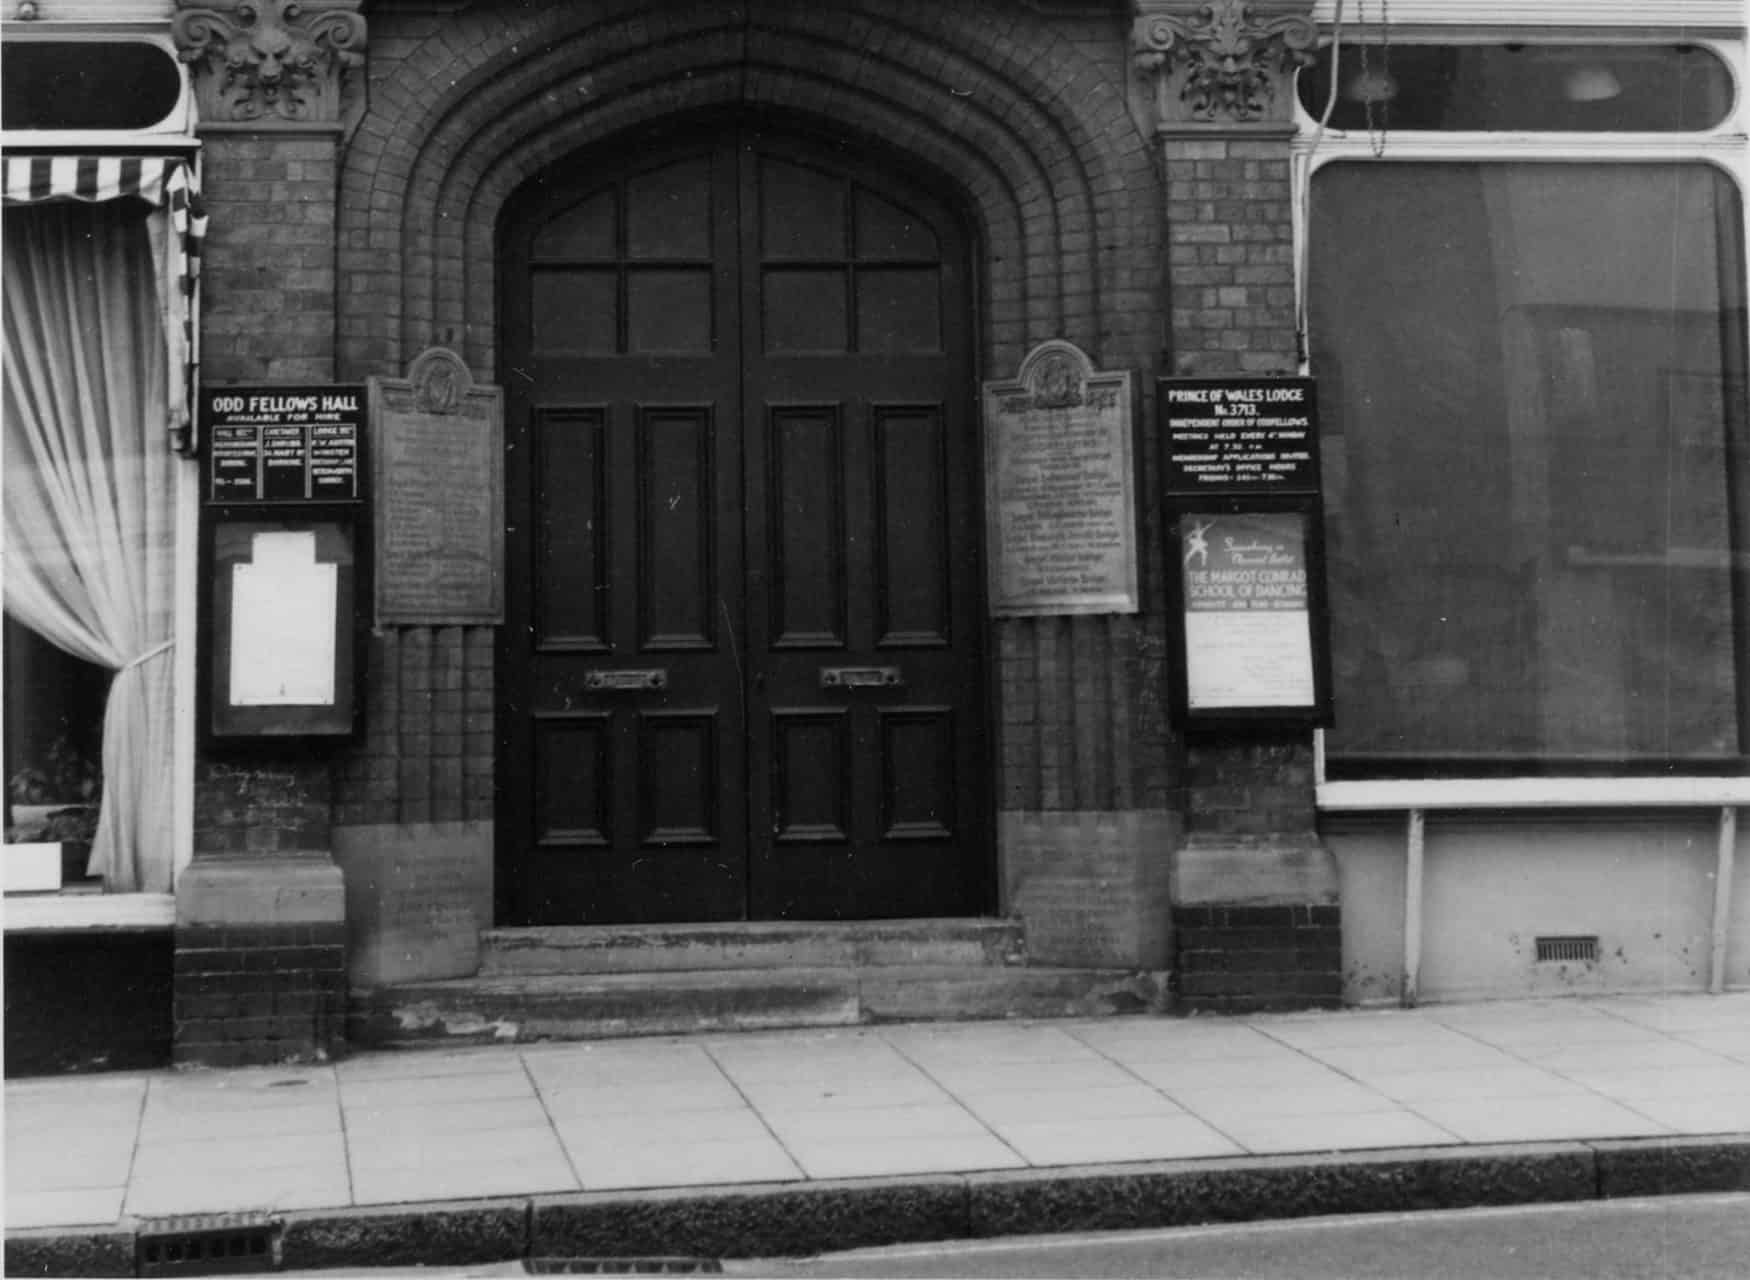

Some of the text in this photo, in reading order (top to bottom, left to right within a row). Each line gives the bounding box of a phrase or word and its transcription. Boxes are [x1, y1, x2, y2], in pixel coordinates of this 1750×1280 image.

[1168, 388, 1304, 402] PRINCE OF WALES LODGE
[212, 395, 359, 412] ODD FELLOWS HALL
[226, 412, 341, 422] AVAILABLE FOR HIRE
